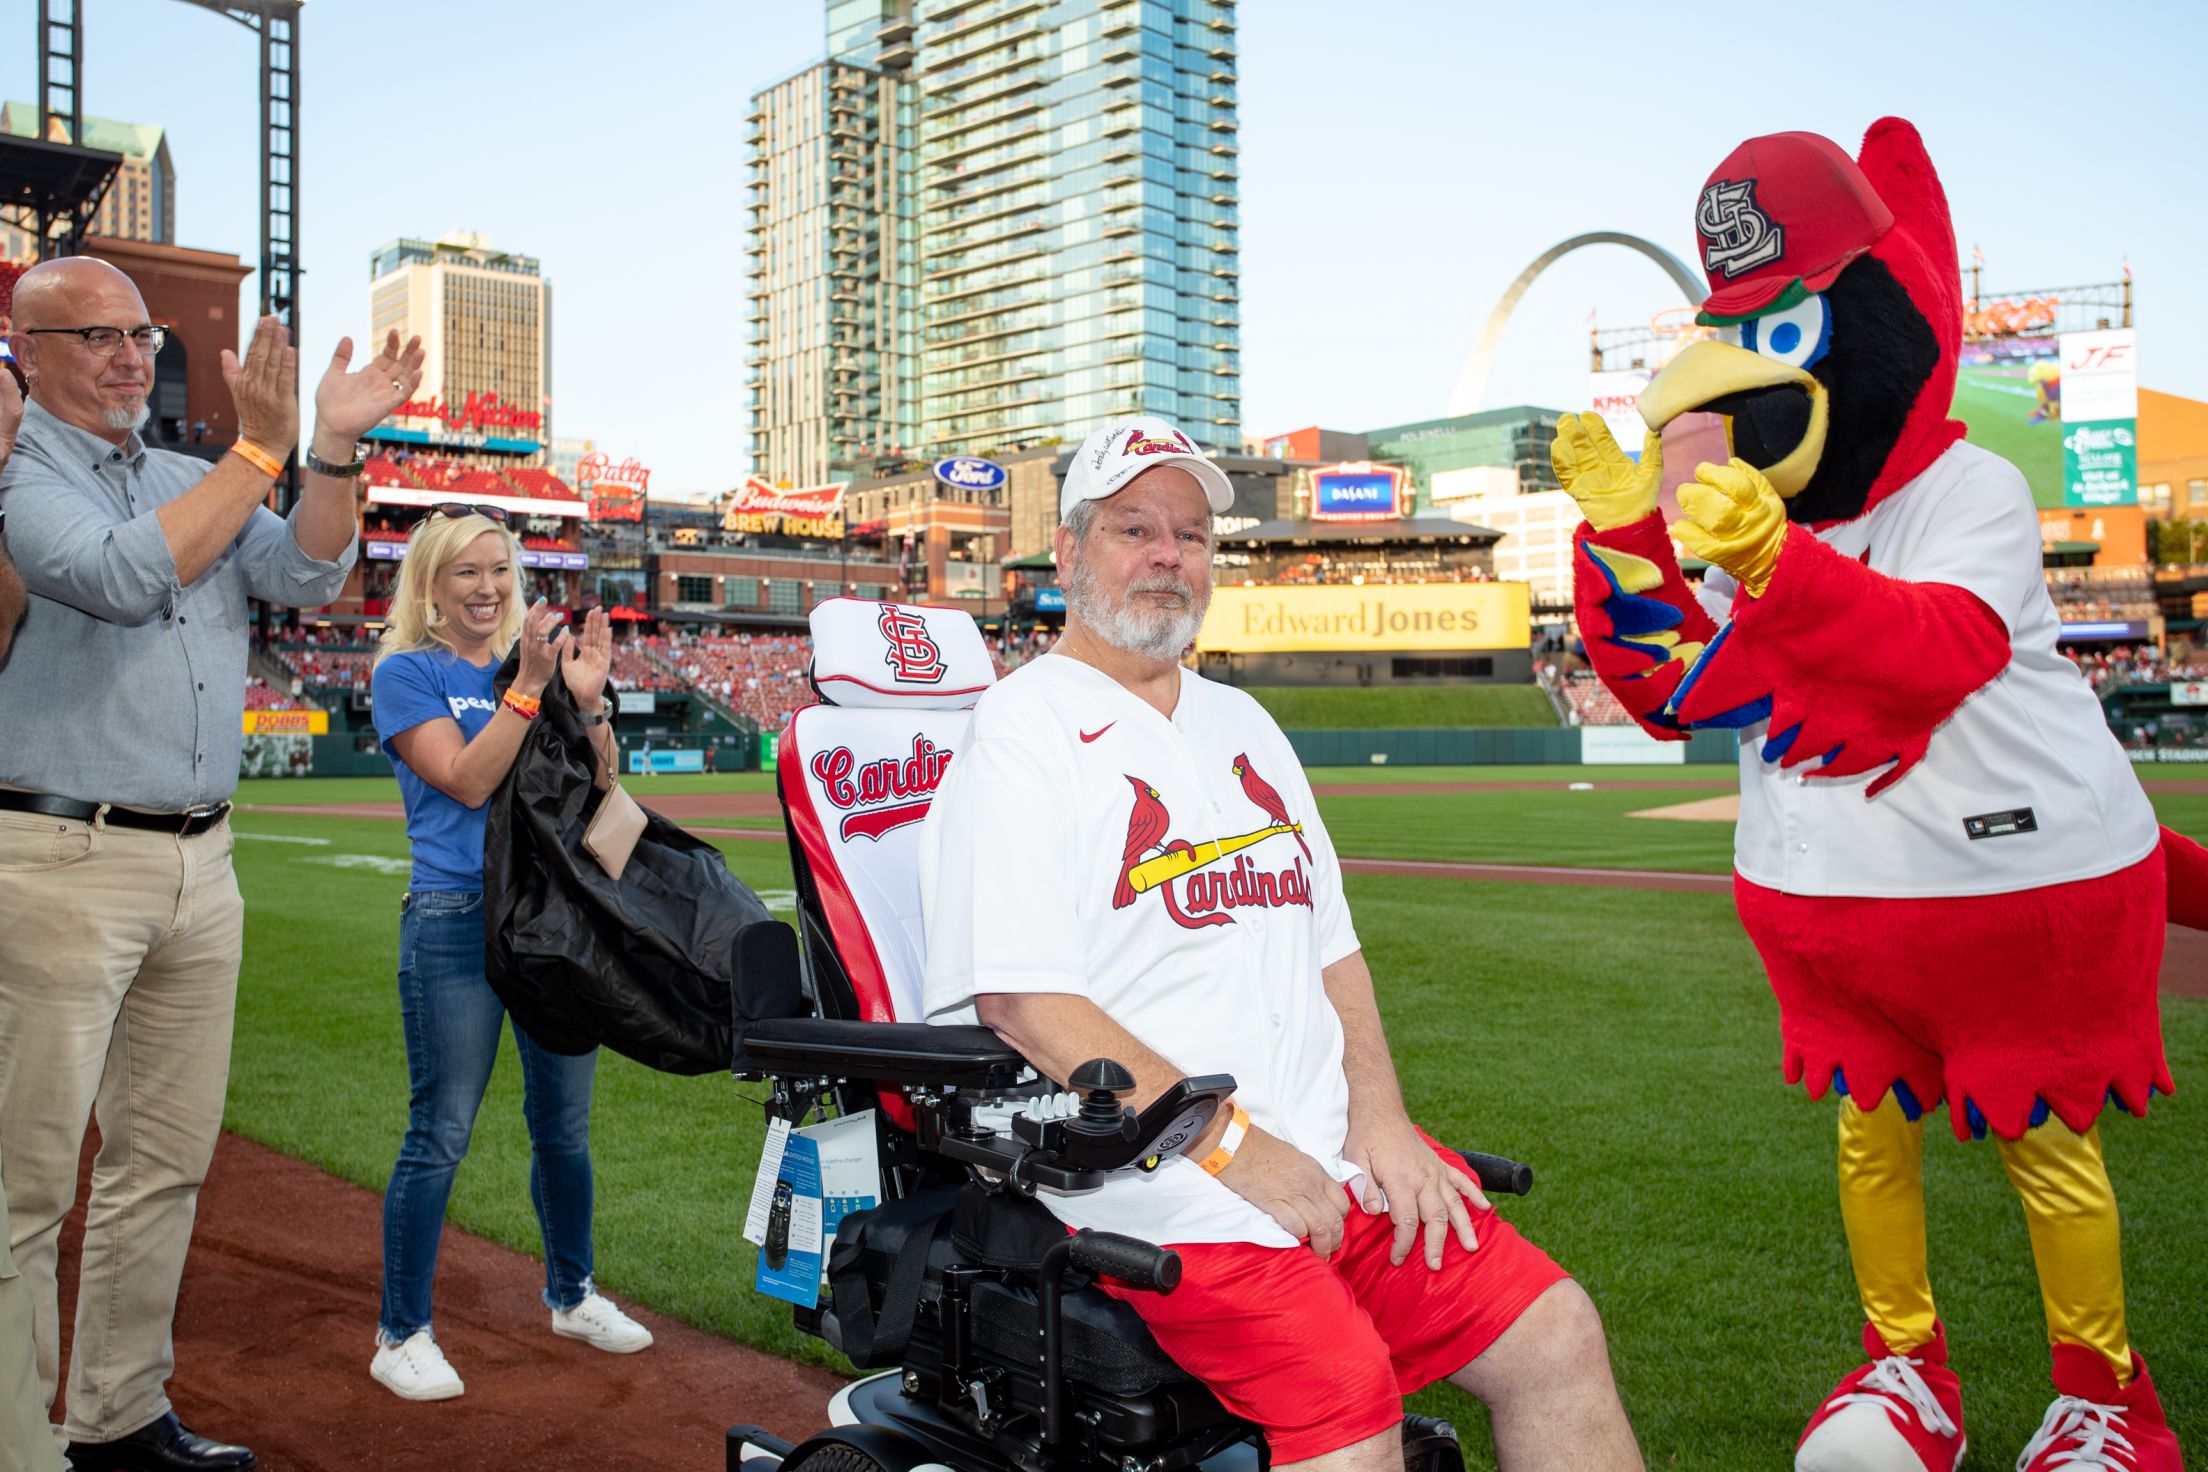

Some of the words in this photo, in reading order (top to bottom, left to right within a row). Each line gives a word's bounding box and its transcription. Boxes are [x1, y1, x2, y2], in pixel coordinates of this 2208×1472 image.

[450, 391, 541, 431] Nation
[576, 452, 652, 494] Bally
[950, 459, 995, 485] Ford
[730, 481, 845, 515] Budweiser
[1331, 486, 1378, 502] DASANI
[725, 512, 780, 534] BREW
[783, 516, 845, 539] HOUSE
[1242, 602, 1366, 636] Edward
[1372, 602, 1479, 637] Jones
[256, 714, 309, 727] DOBBS
